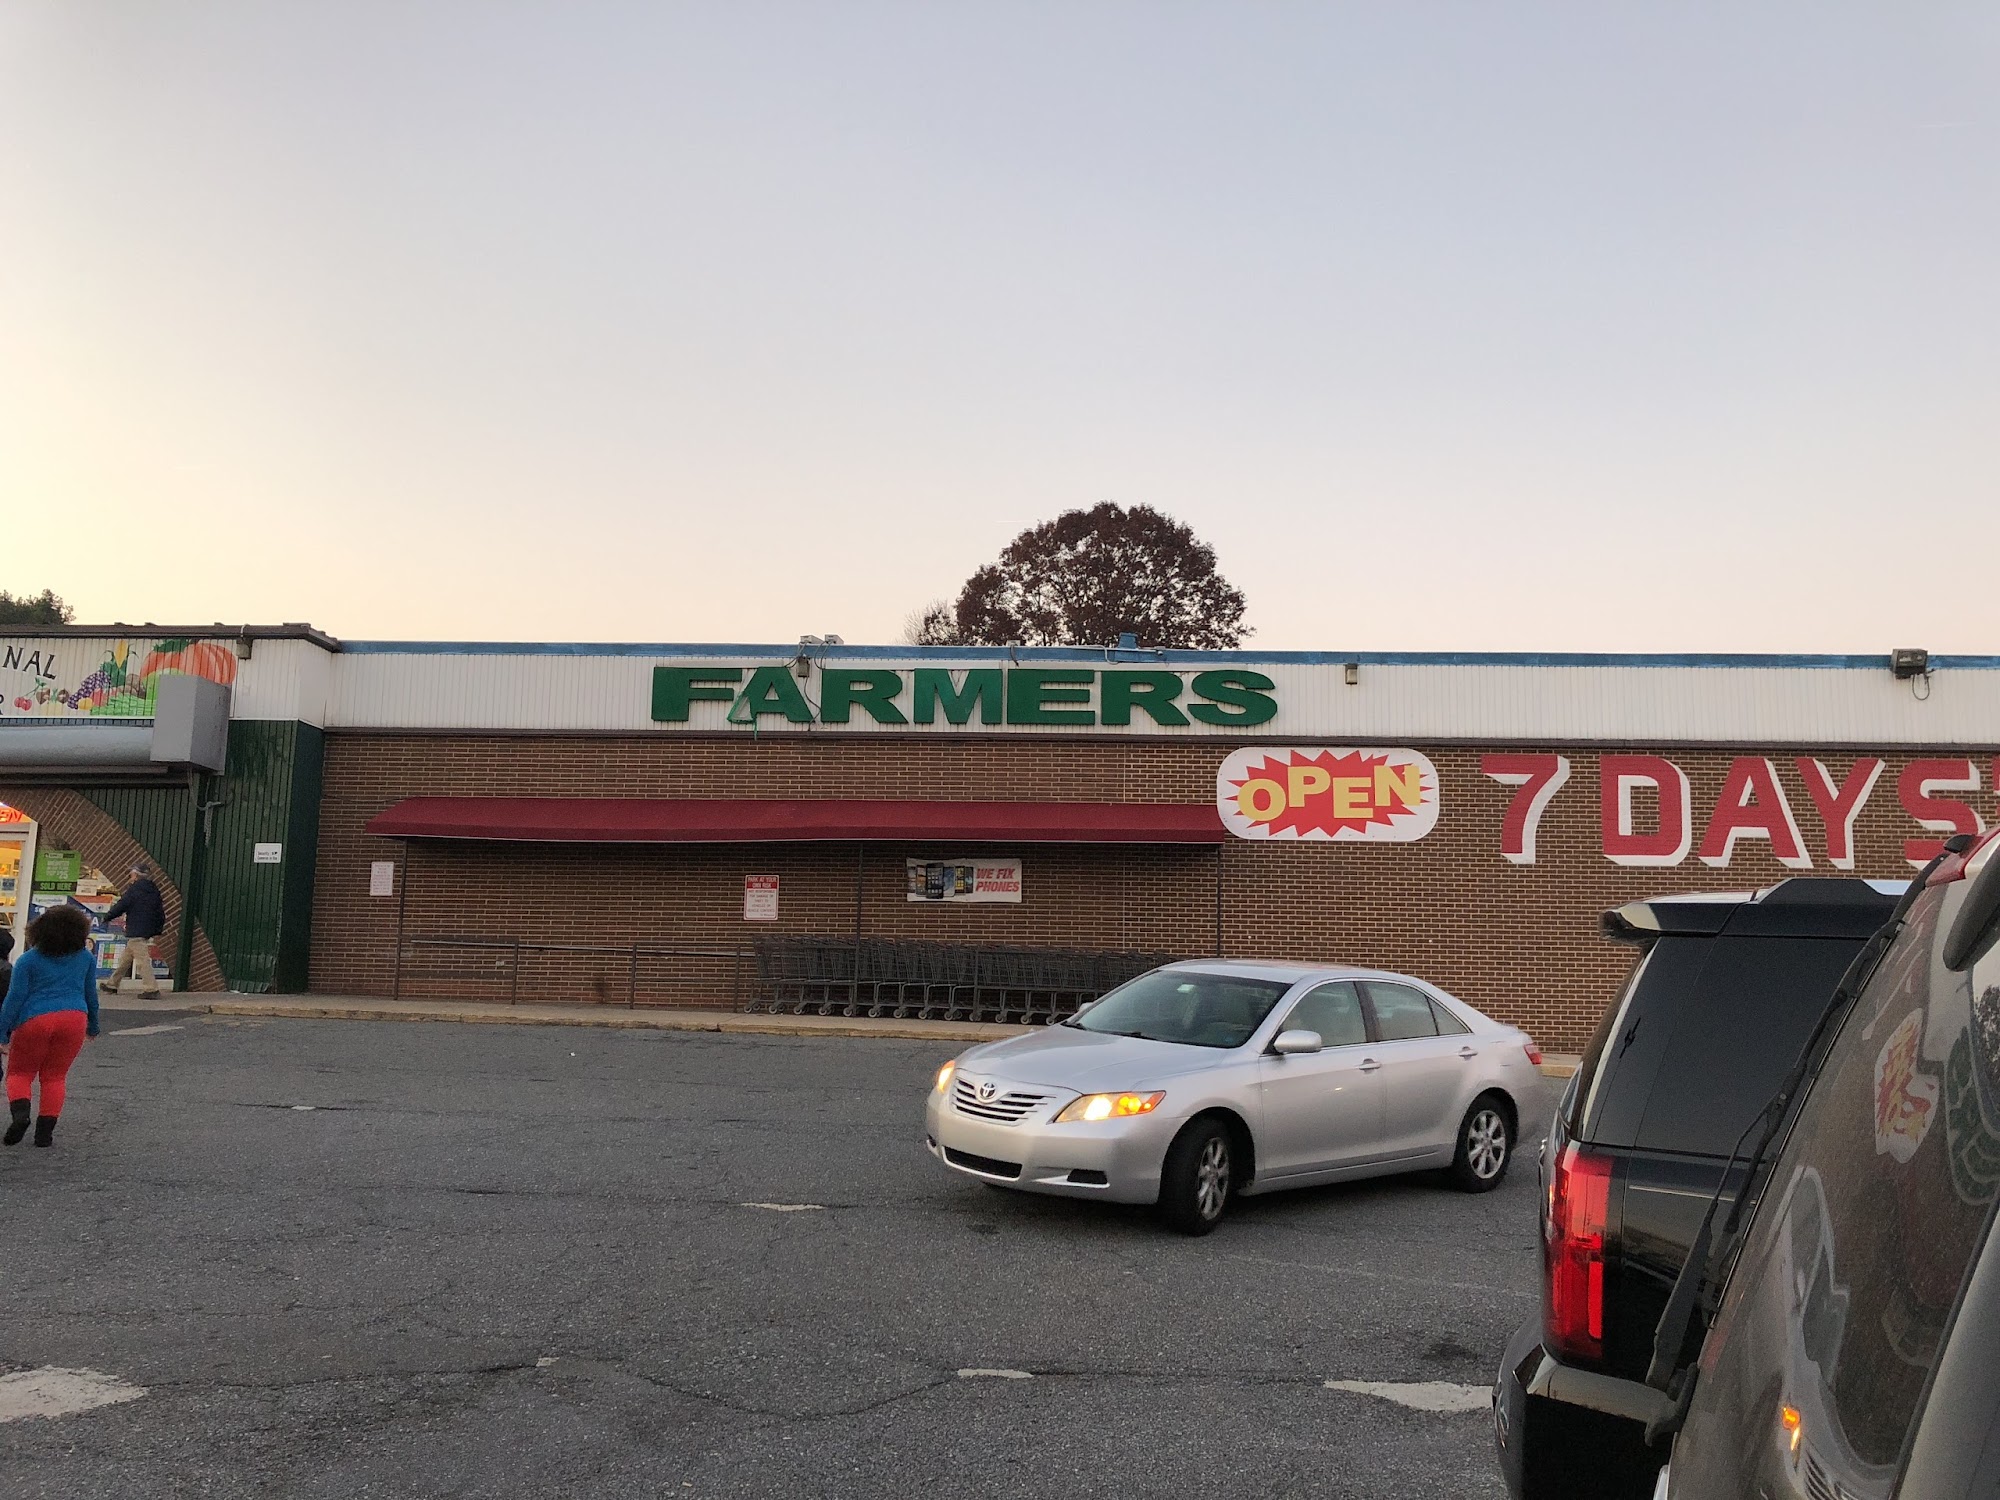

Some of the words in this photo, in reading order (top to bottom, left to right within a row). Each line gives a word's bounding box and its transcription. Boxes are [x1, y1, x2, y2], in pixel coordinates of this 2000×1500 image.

[2, 645, 57, 680] NAL
[651, 666, 1278, 726] FARMERS
[1237, 764, 1421, 821] OPEN
[1480, 754, 1571, 864] 7
[1600, 755, 1987, 871] DAYS
[975, 881, 1020, 892] PHONES
[976, 868, 994, 879] WE
[996, 868, 1015, 879] FIX
